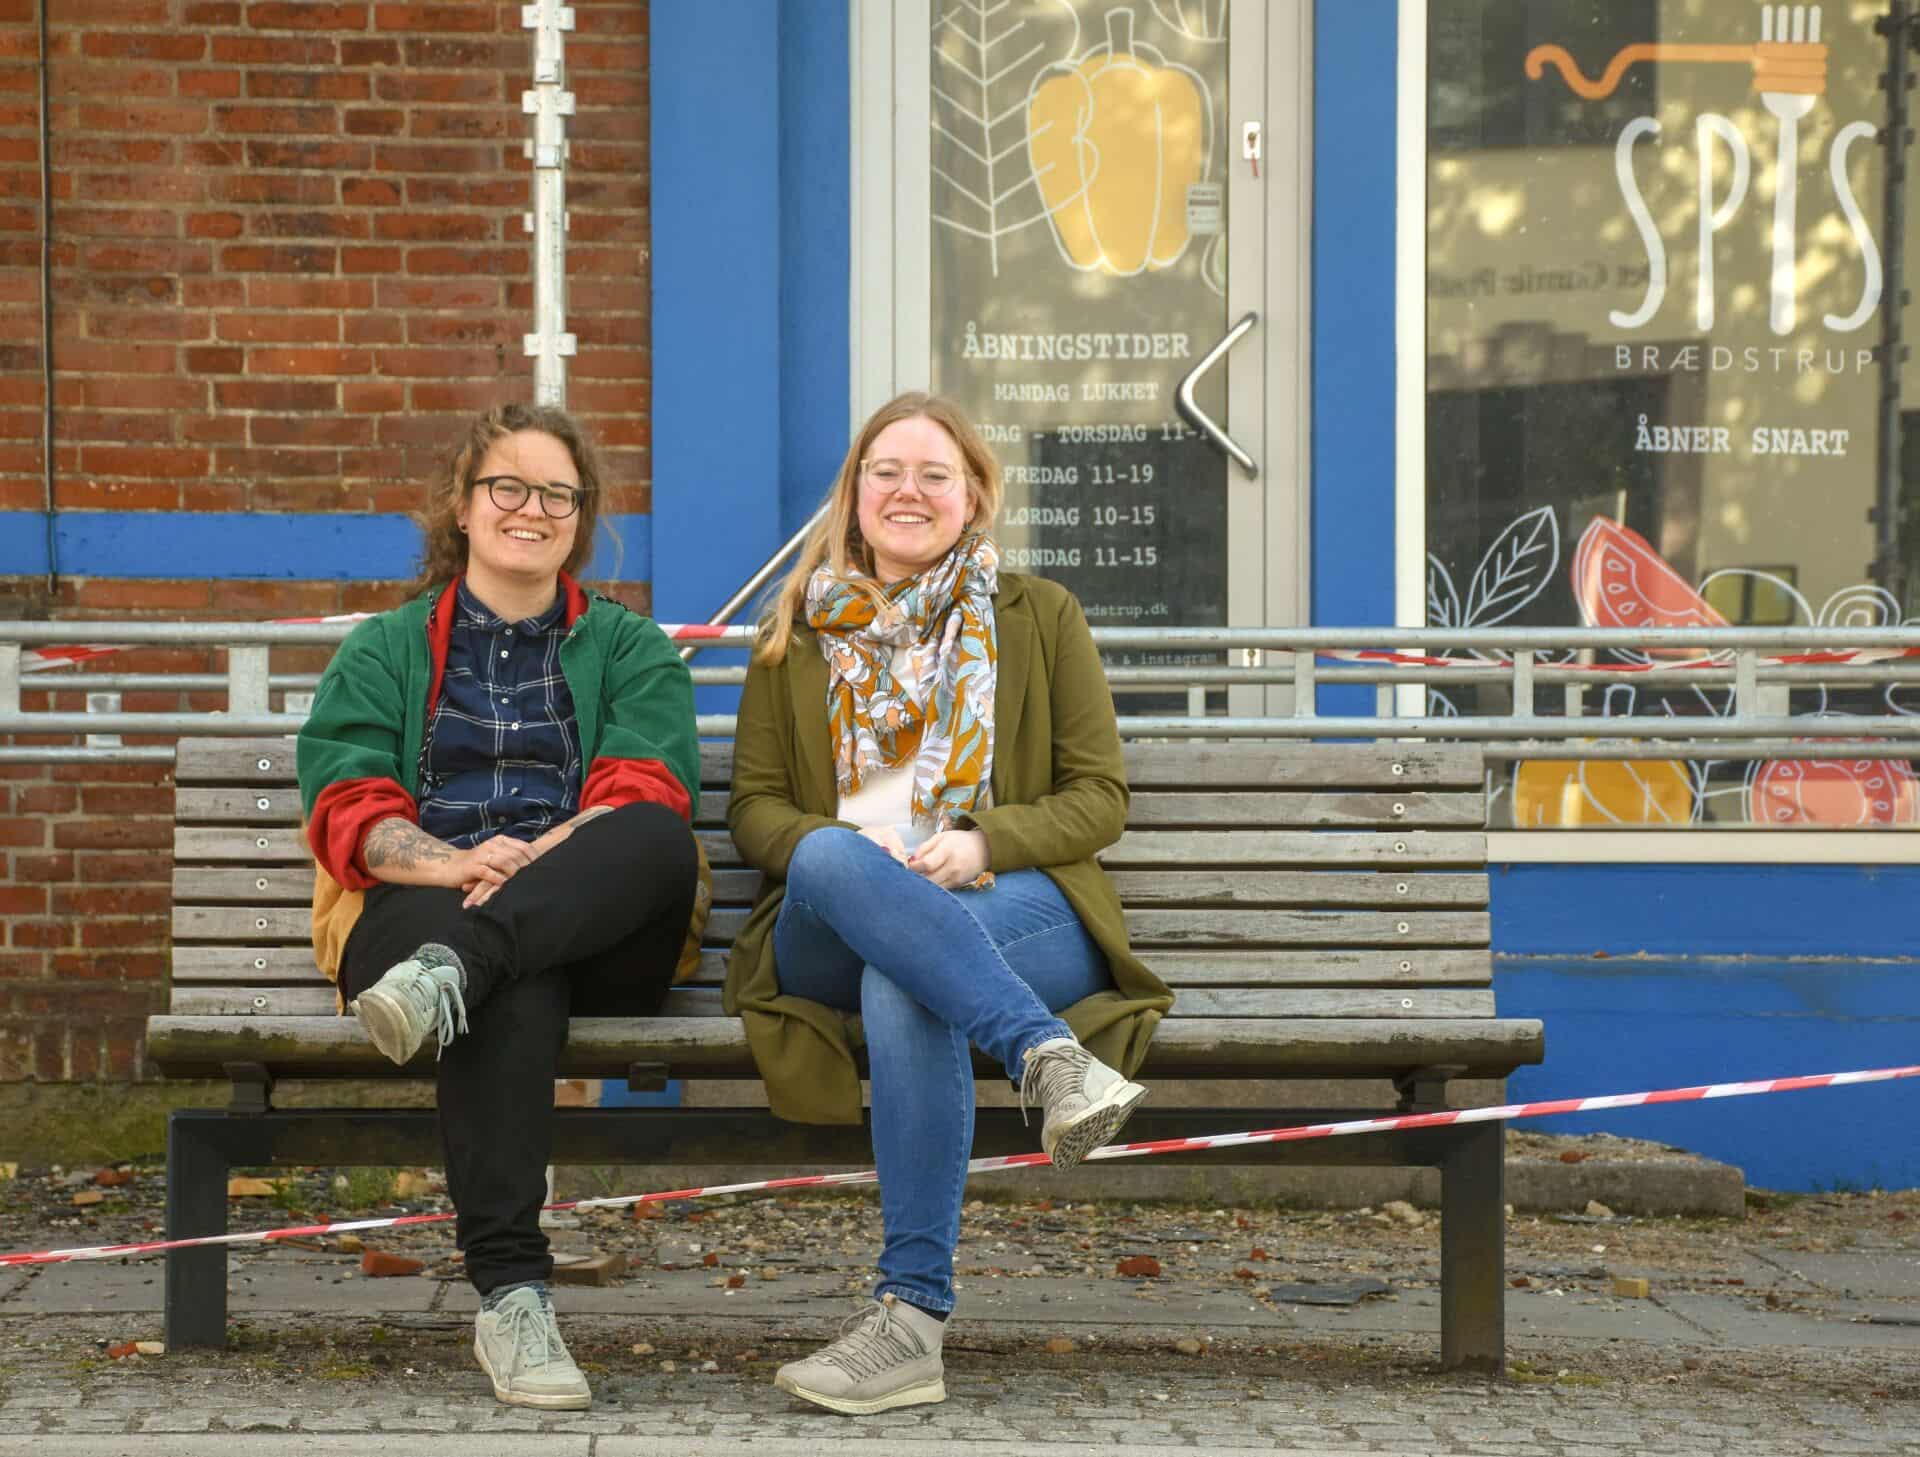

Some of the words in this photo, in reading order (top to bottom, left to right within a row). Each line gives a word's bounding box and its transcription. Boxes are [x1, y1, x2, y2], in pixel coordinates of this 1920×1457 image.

[1609, 100, 1884, 335] SPIS
[962, 320, 1191, 360] ÅBNINGSTIDER
[1615, 345, 1874, 374] BRÆDSTRUP
[994, 383, 1070, 401] MANDAG
[1082, 382, 1160, 401] LUKKET
[975, 424, 1021, 443] DAG
[1057, 423, 1147, 443] TORSDAG
[1635, 414, 1730, 453] ÅBNER
[1752, 429, 1849, 456] SNART
[1004, 464, 1079, 485] FREDAG
[1092, 464, 1154, 484] 11-19
[1004, 507, 1080, 527] LØRDAG
[1093, 506, 1156, 526] 10-15
[1005, 548, 1081, 568] SØNDAG
[1095, 547, 1157, 567] 11-15
[1083, 602, 1169, 619] edstrup.dk
